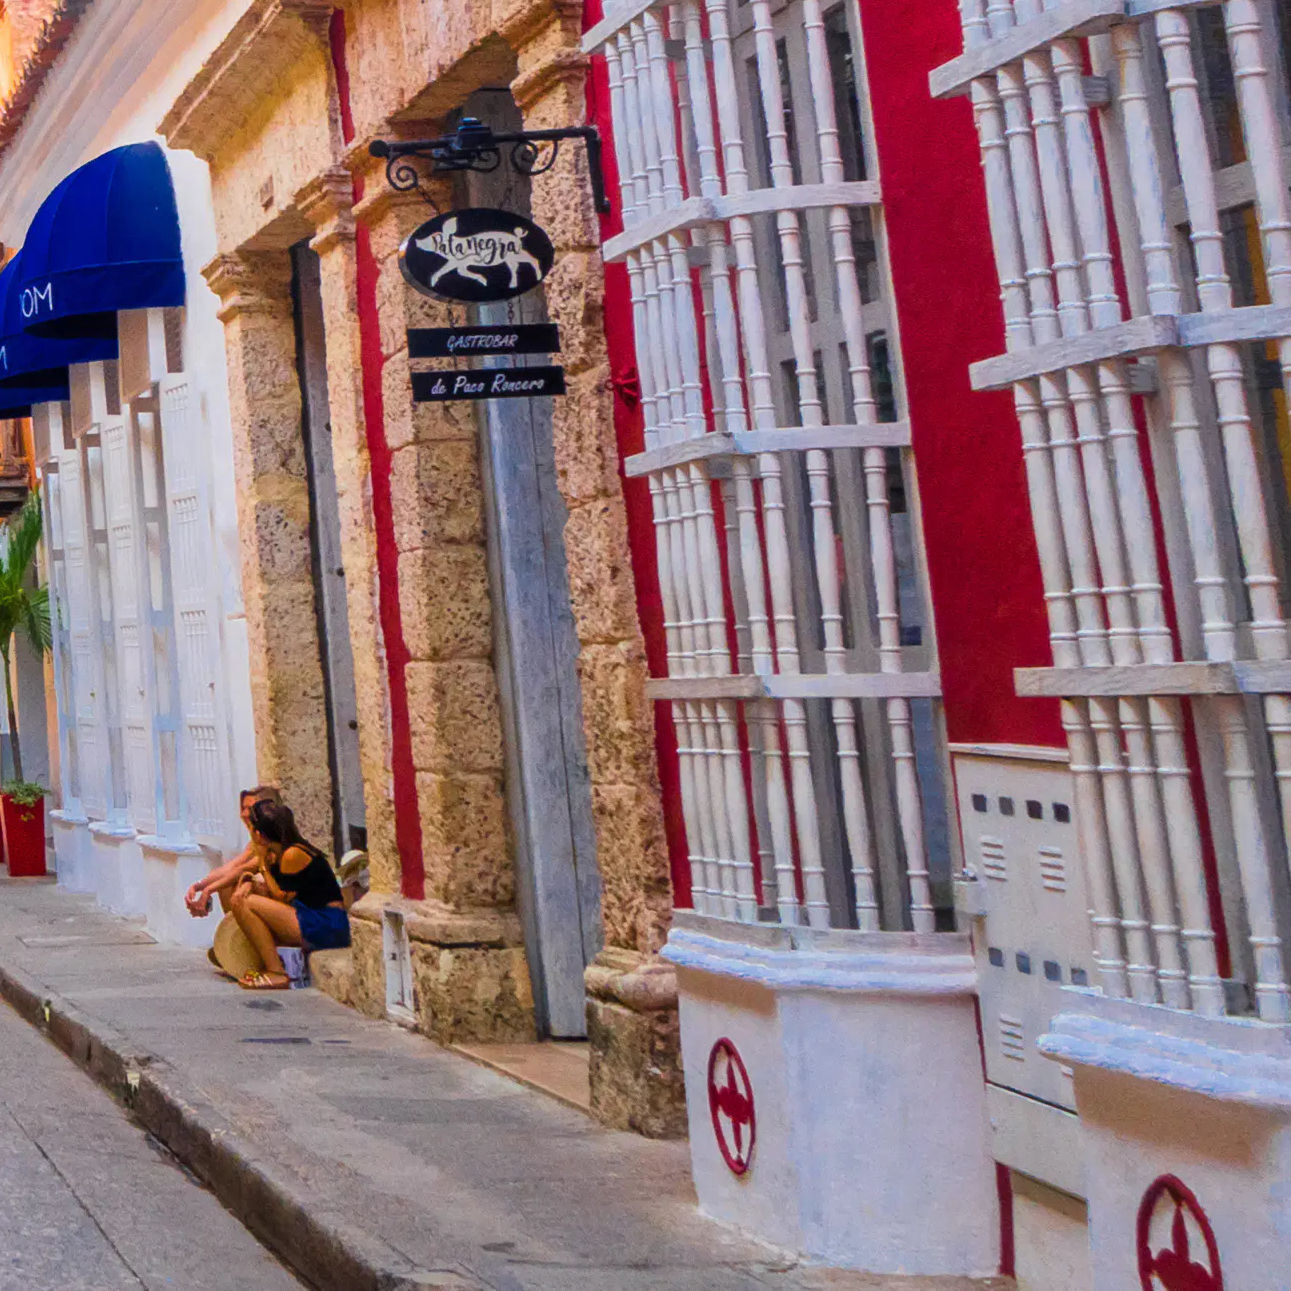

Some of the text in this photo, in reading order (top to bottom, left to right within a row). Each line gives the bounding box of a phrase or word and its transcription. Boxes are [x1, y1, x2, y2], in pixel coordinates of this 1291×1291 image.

[432, 233, 463, 256] Pata
[20, 282, 53, 318] OM
[447, 334, 518, 351] GASTROBAR
[431, 373, 545, 395] de Paco Roncero
